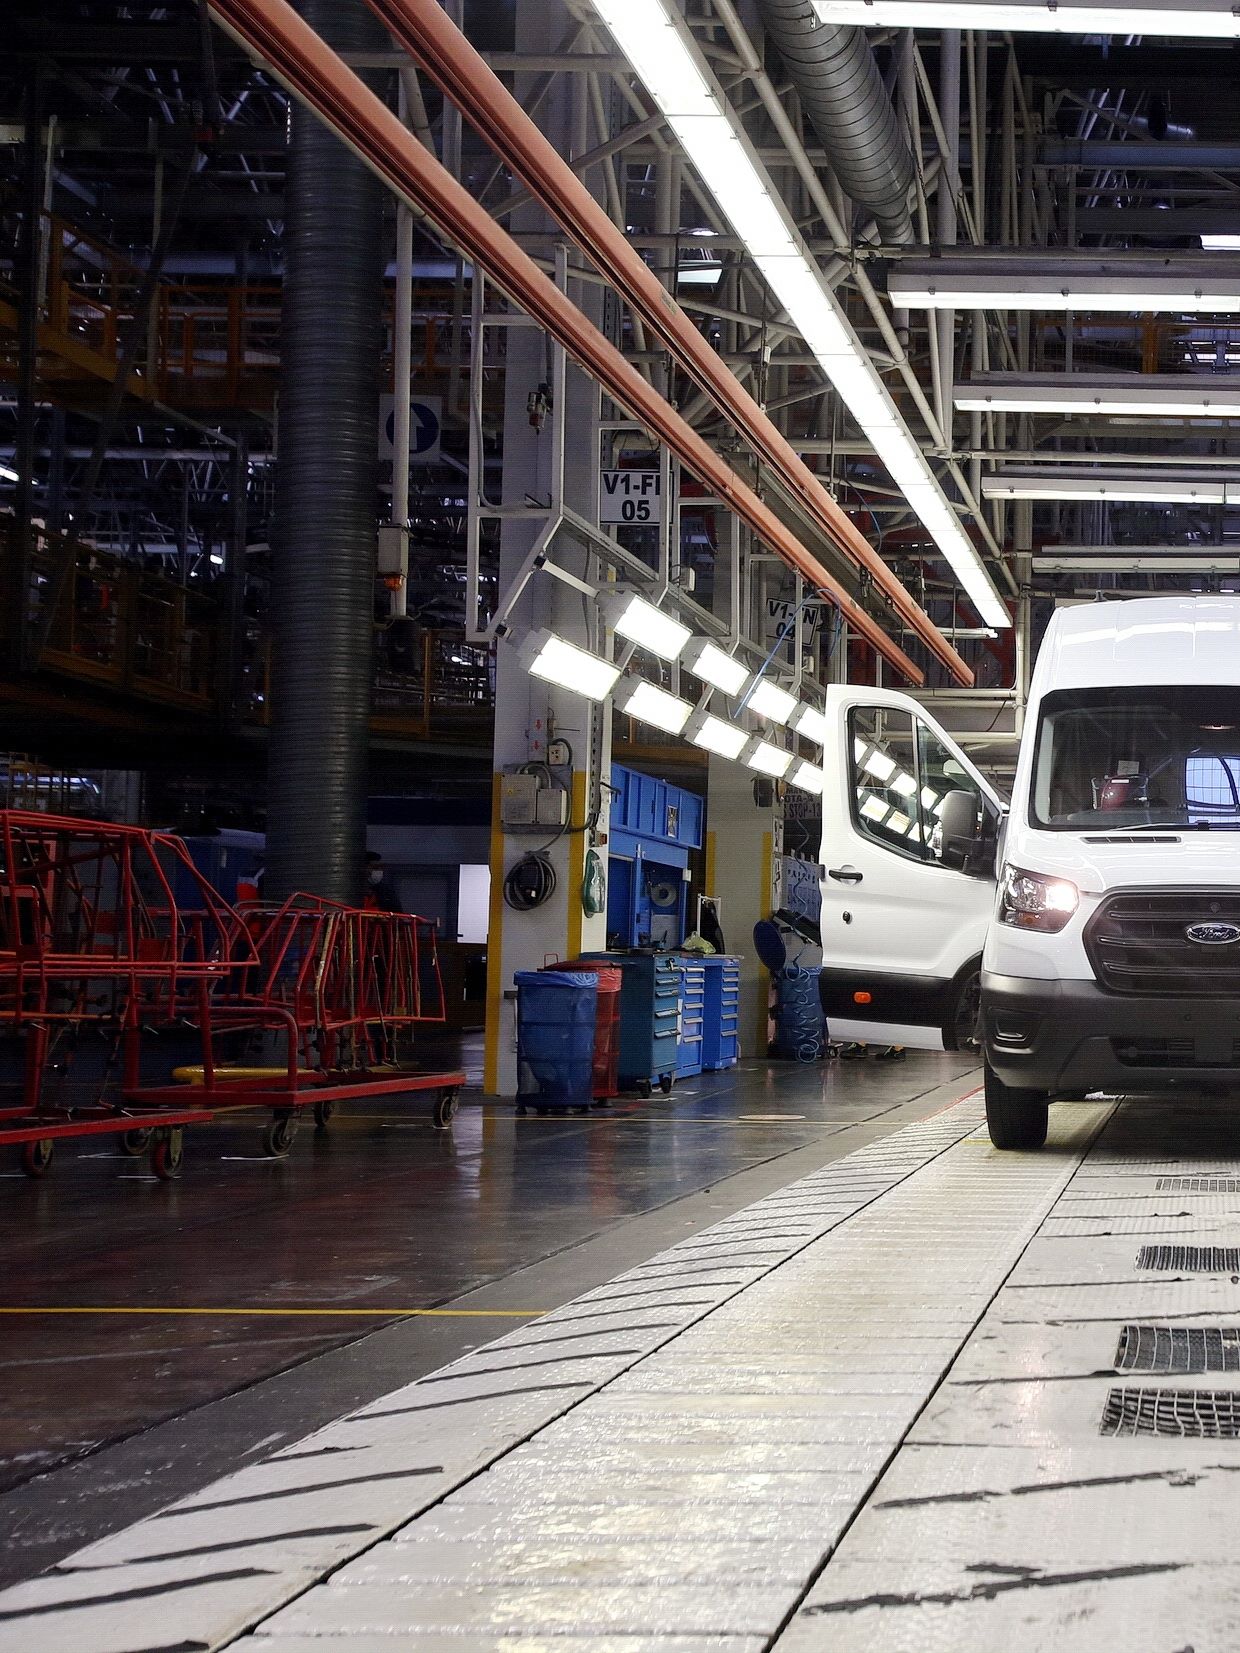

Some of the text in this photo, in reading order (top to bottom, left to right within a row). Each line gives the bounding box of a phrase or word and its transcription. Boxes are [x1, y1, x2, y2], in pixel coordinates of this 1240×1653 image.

[603, 474, 660, 495] V1-F
[621, 500, 650, 520] 05
[769, 601, 816, 624] V1-N
